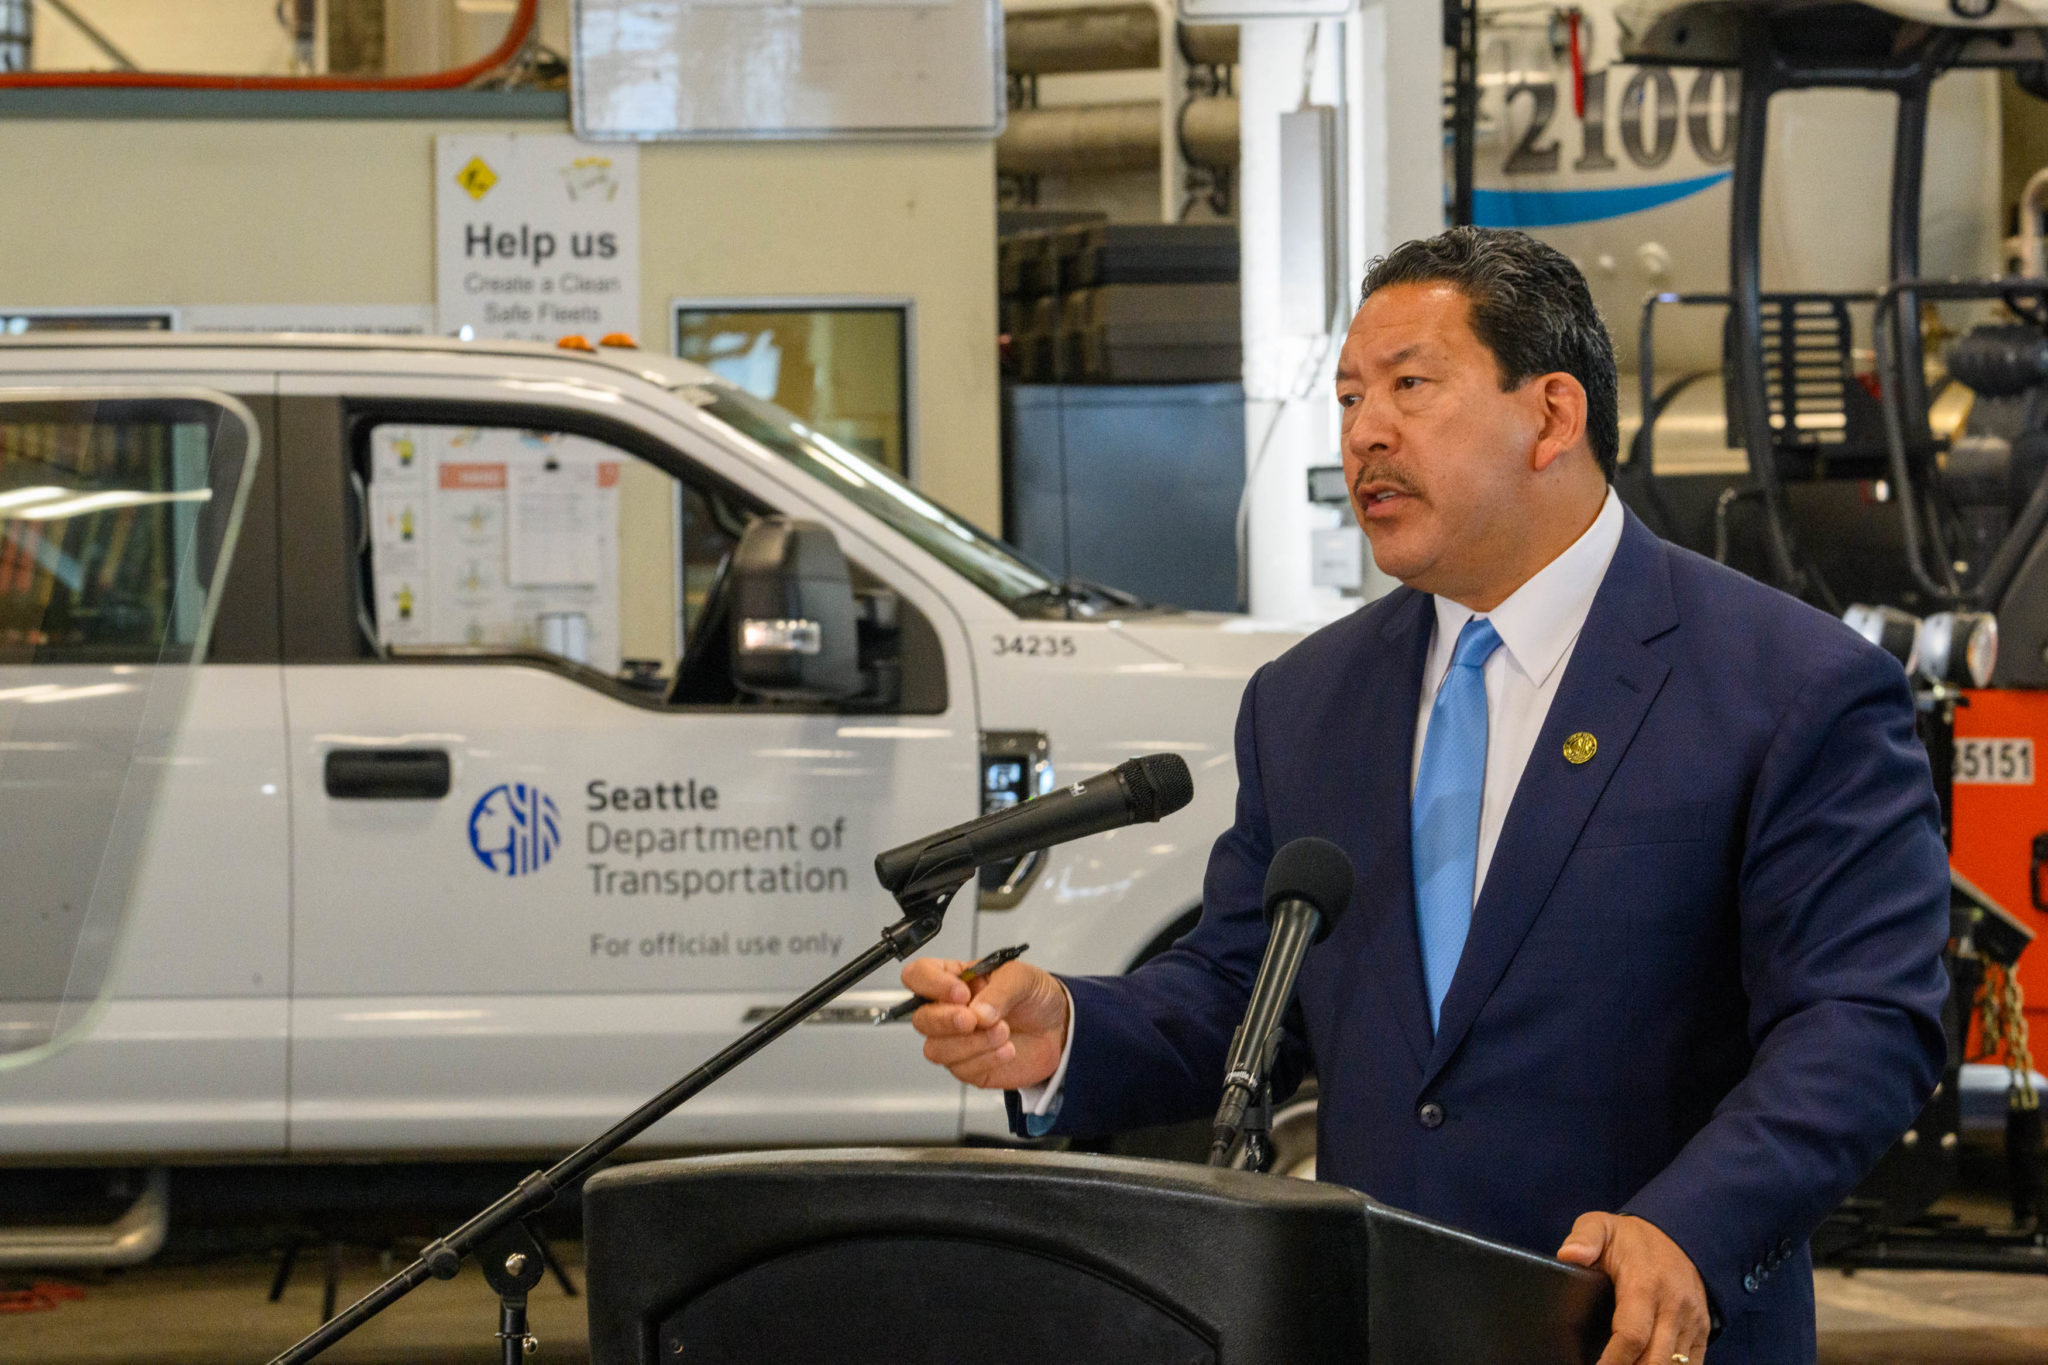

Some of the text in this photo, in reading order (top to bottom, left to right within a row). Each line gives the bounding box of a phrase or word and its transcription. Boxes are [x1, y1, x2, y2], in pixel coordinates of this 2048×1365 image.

[1504, 67, 1742, 174] 2100
[466, 223, 618, 266] Help us
[464, 272, 620, 294] Create a Clean
[484, 302, 601, 324] Safe Fleets
[992, 635, 1076, 656] 34235
[587, 778, 718, 811] Seattle
[587, 817, 847, 858] Department of
[588, 862, 848, 899] Transportation
[590, 931, 843, 957] For official use only
